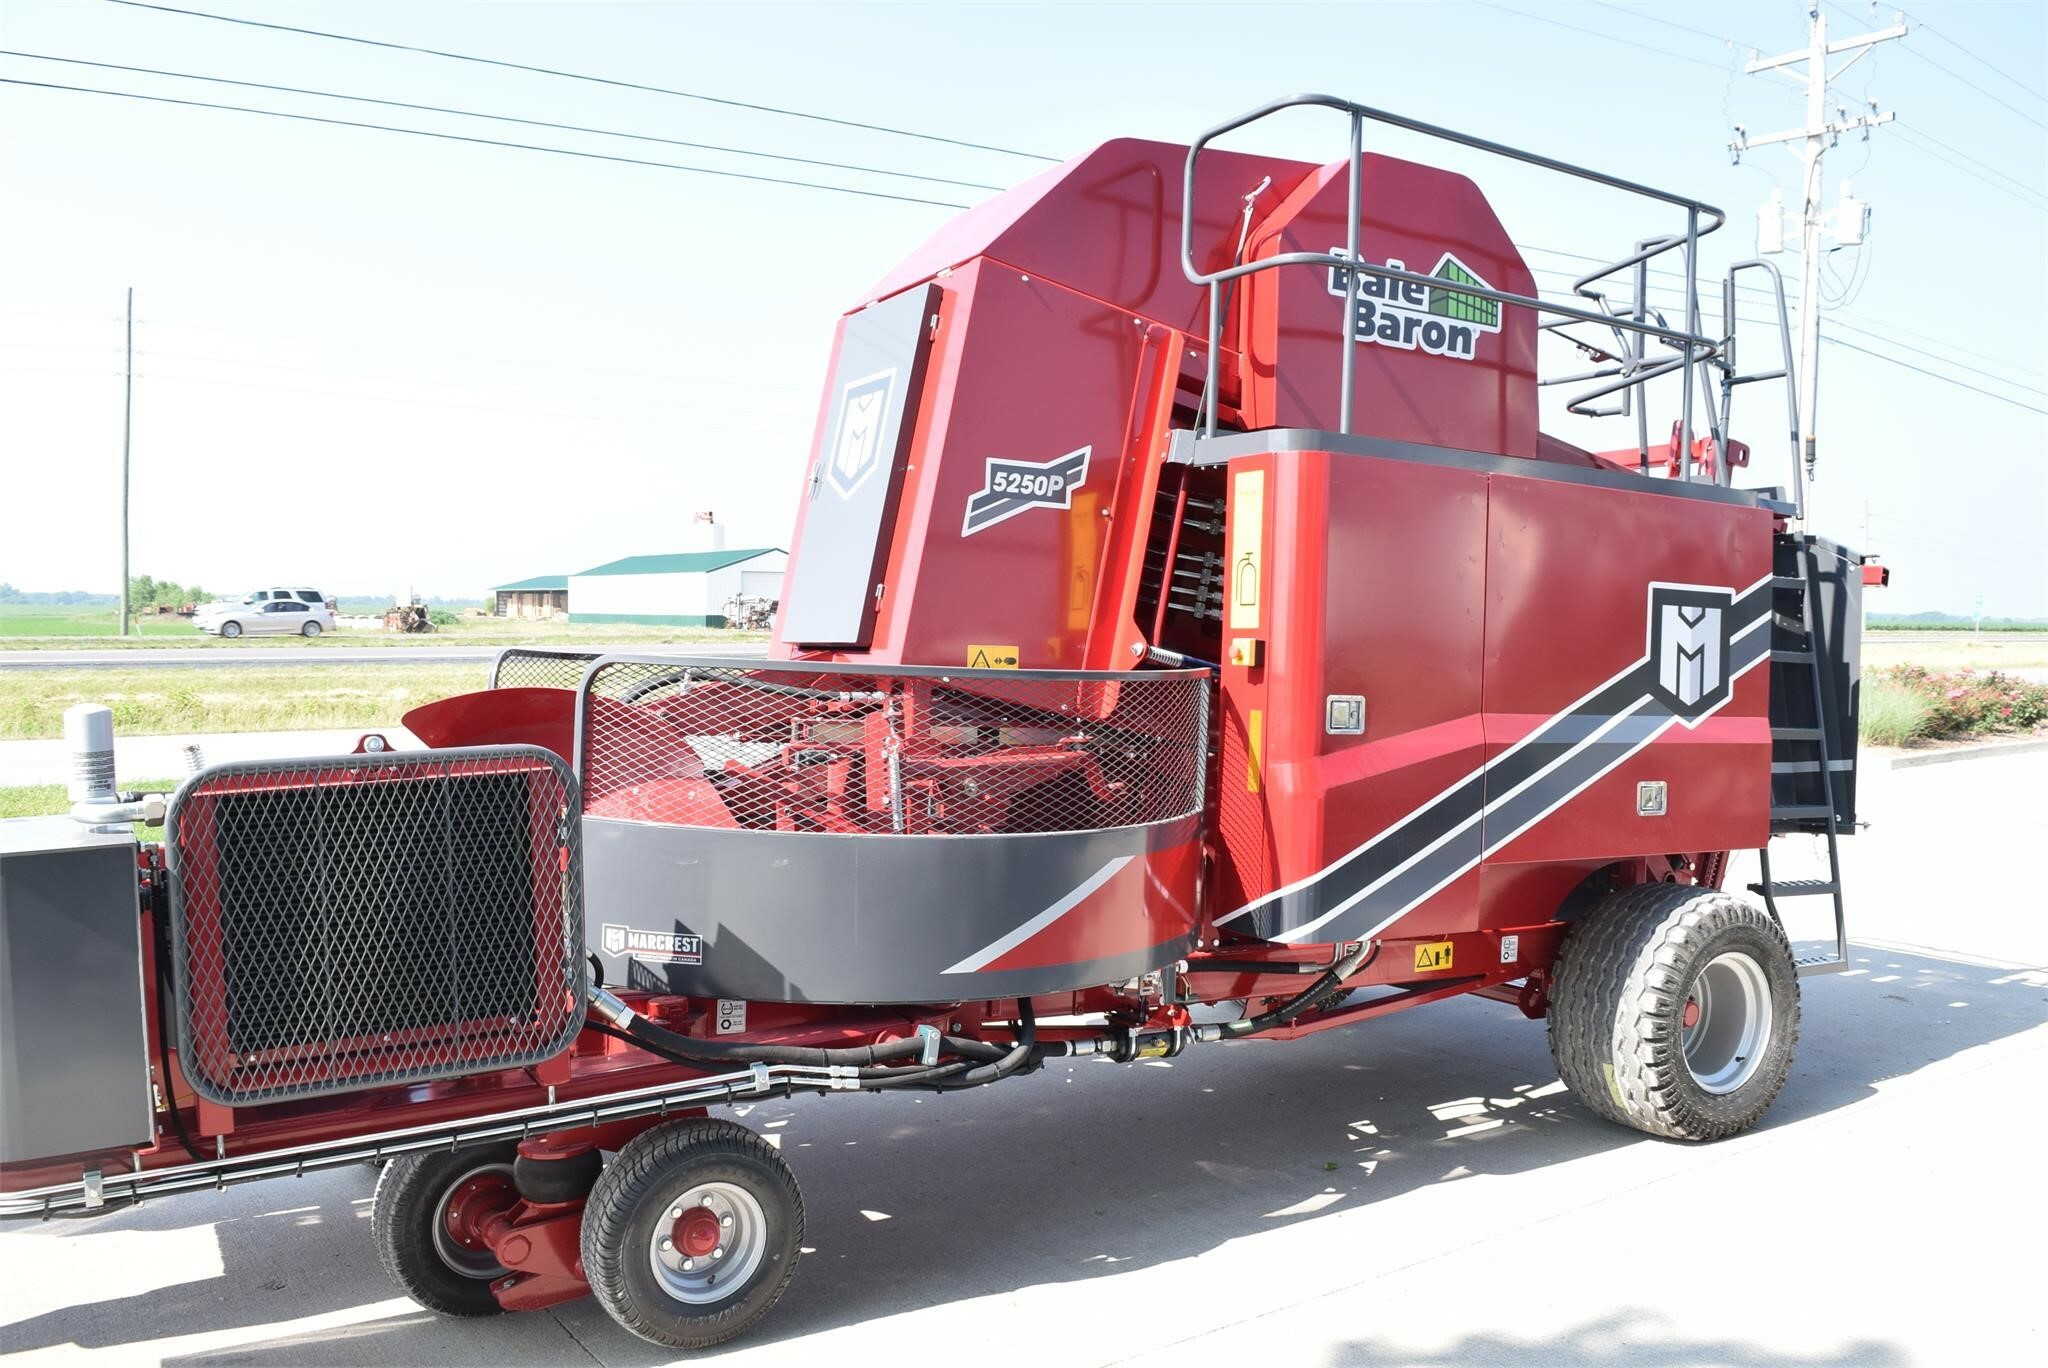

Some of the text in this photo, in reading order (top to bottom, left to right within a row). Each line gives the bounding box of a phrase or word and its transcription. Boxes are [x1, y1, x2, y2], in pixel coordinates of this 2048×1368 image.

[1350, 298, 1472, 355] Baron
[993, 471, 1065, 496] 5250P
[627, 932, 699, 953] MARCREST
